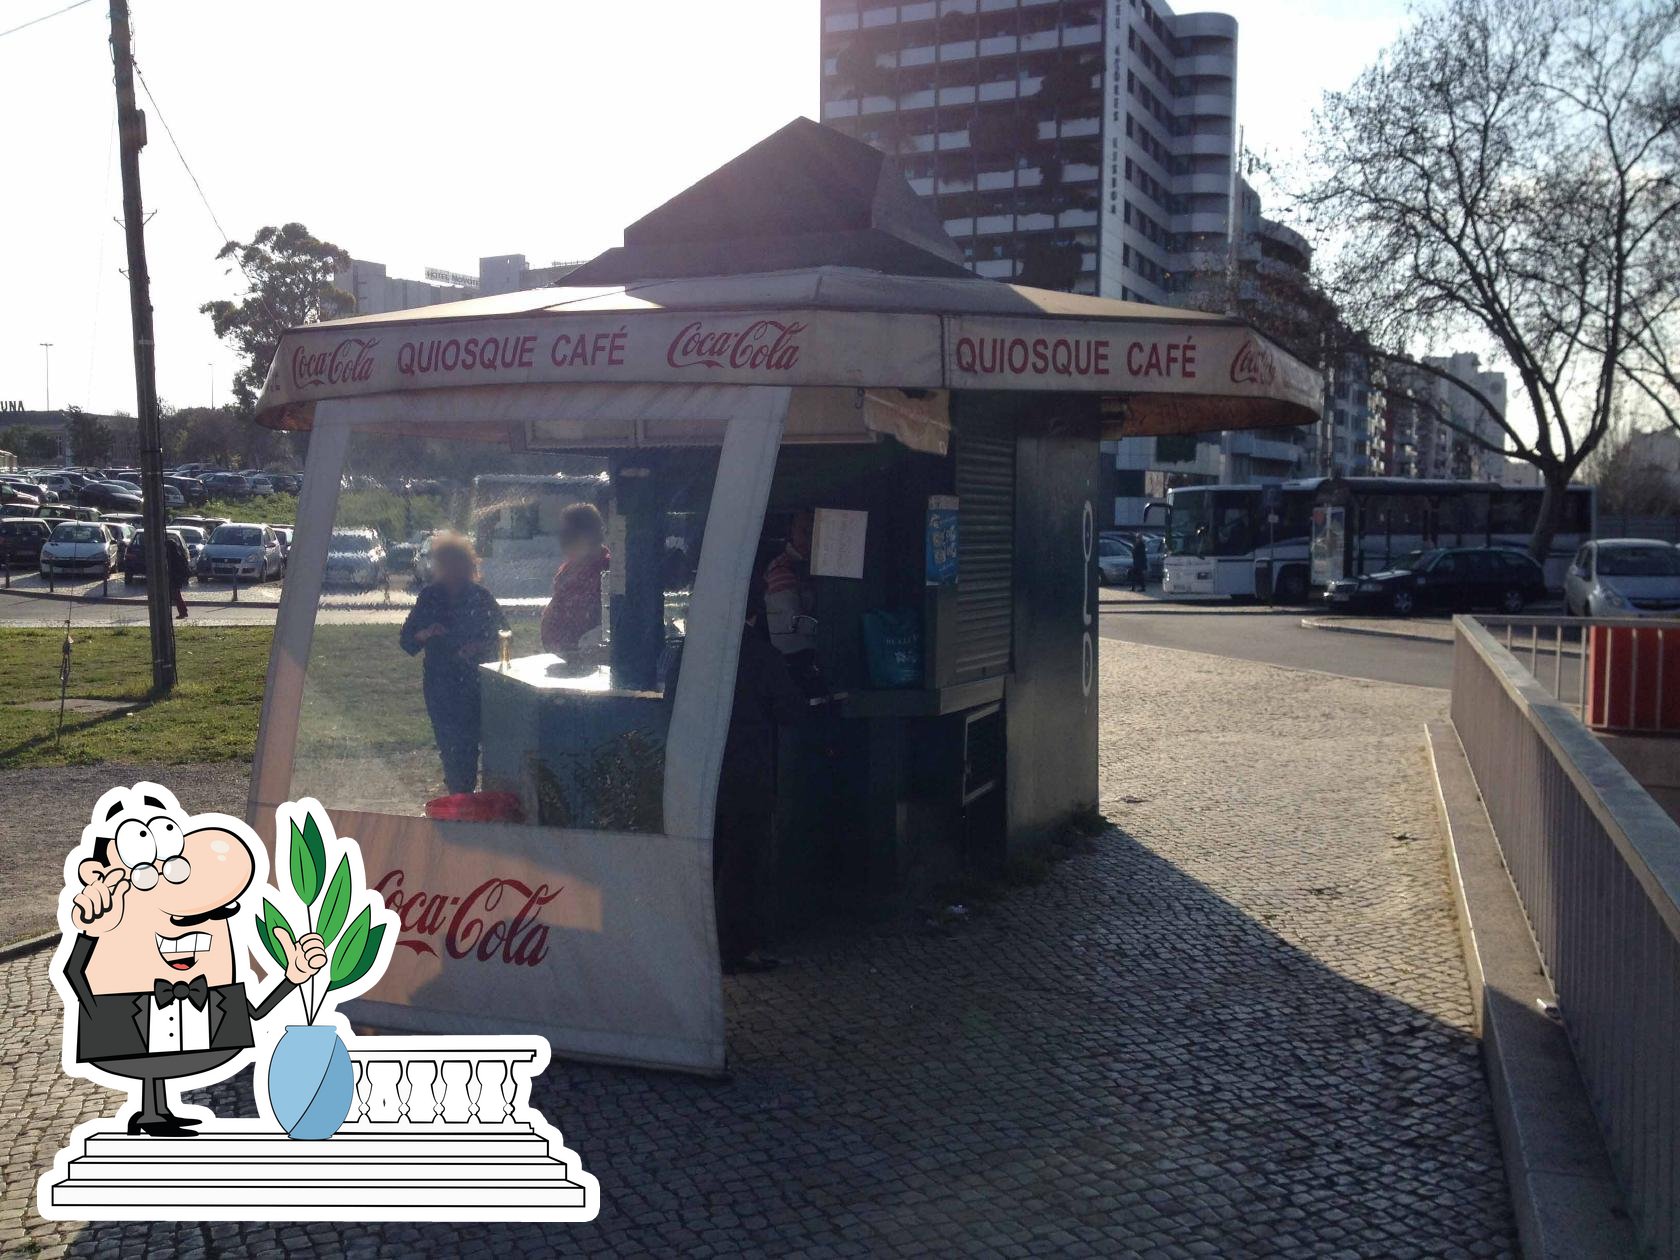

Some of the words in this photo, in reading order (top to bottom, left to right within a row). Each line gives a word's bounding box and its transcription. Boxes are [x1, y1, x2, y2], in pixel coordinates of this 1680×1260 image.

[293, 337, 384, 389] Coca-Cola
[397, 336, 537, 376] QUIOSQUE
[551, 325, 628, 368] CAFÉ
[667, 320, 808, 371] Coca-Cola
[956, 337, 1109, 378] QUIOSQUE
[1127, 336, 1197, 379] CAFÉ
